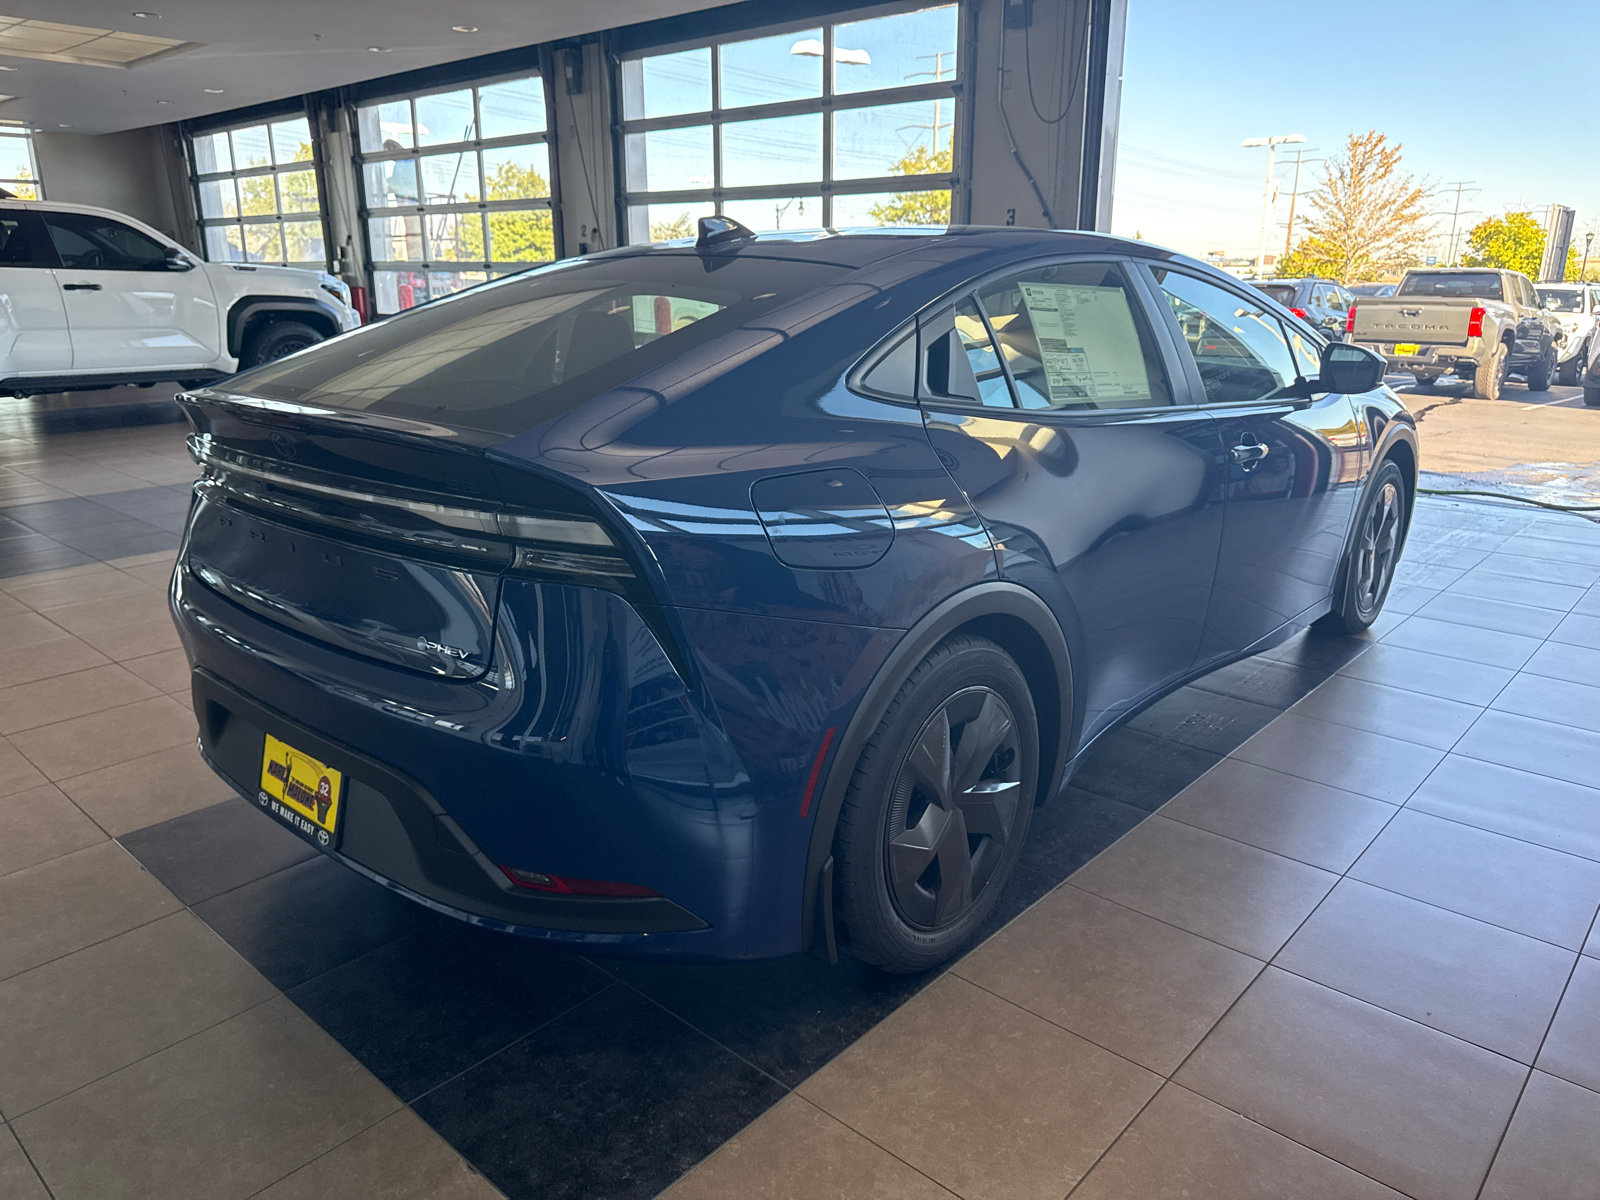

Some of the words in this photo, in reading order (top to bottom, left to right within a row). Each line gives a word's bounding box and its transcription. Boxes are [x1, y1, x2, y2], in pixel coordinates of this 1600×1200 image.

[1006, 208, 1016, 226] 3
[581, 224, 587, 237] 2
[1371, 323, 1449, 331] TACOMA
[219, 515, 399, 582] PRIUS
[426, 641, 472, 660] PHEV
[286, 781, 315, 811] MALONE
[320, 782, 329, 797] 32
[271, 800, 279, 813] WE
[280, 806, 294, 822] MAKE
[294, 815, 300, 826] IT
[300, 819, 315, 835] EASY
